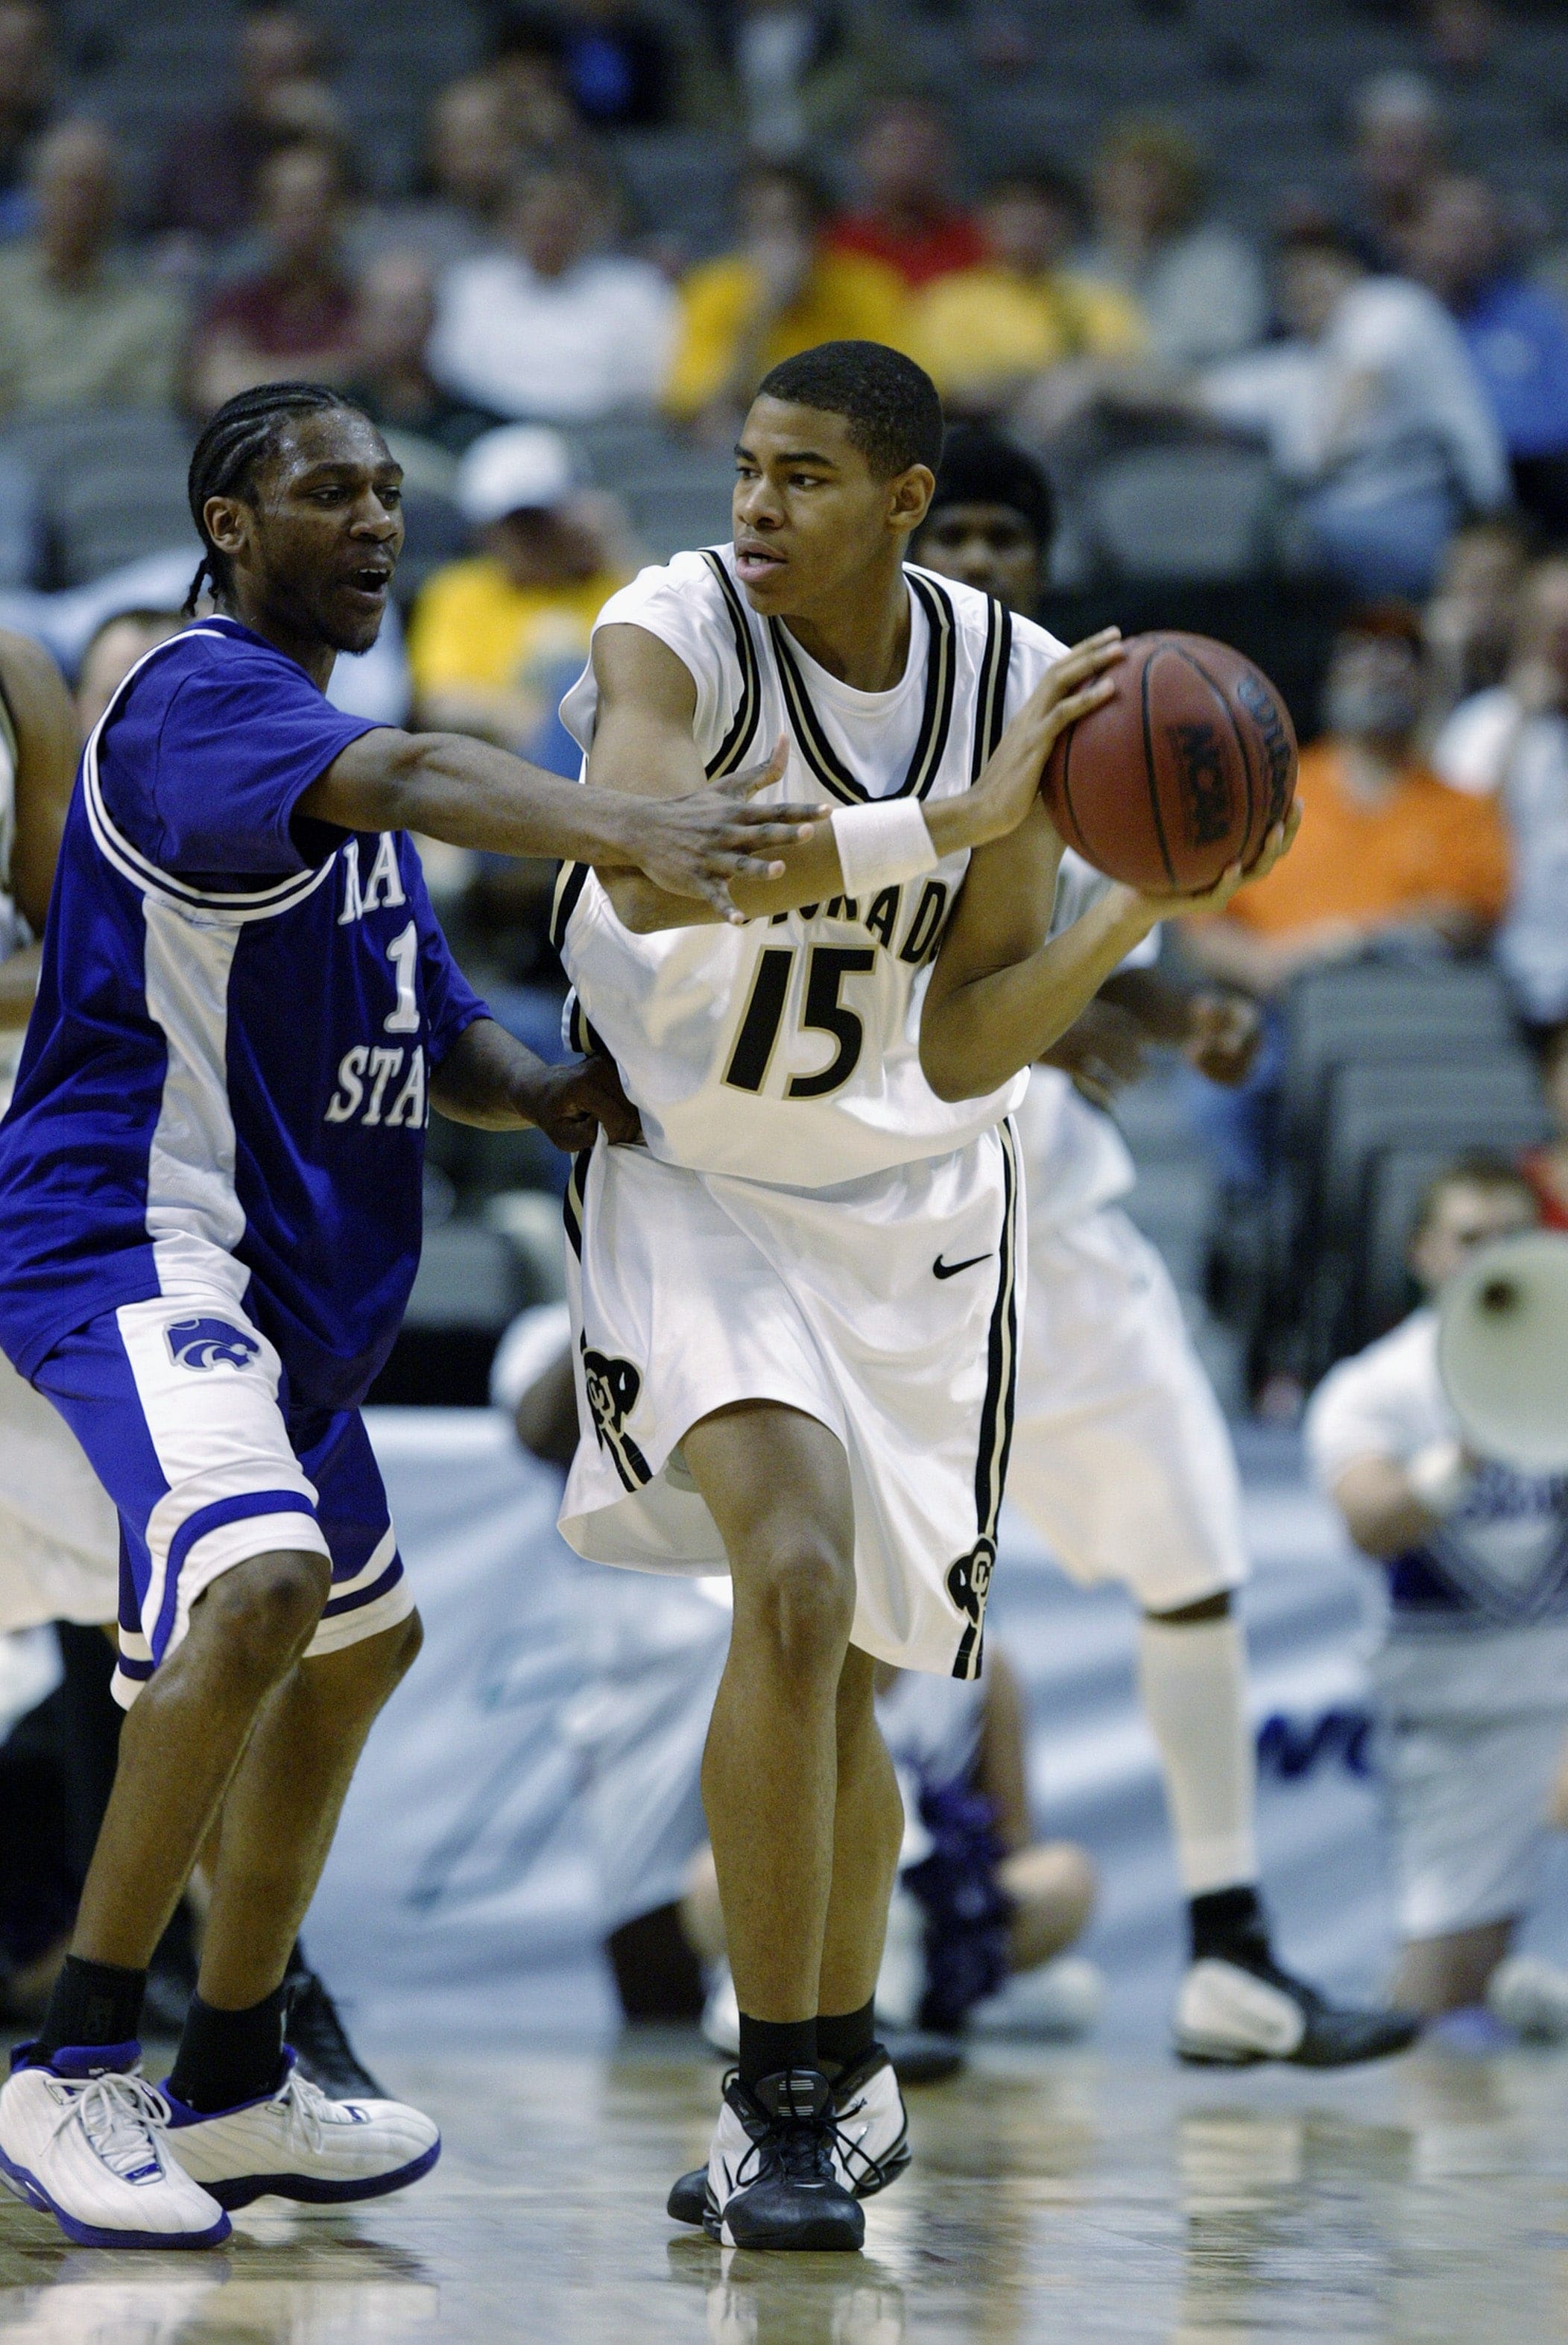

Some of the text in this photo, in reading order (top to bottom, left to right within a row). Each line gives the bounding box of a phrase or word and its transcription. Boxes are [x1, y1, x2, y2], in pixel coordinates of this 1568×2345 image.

[384, 920, 422, 1033] 1
[720, 942, 879, 1100] 15
[325, 1044, 430, 1129] STA
